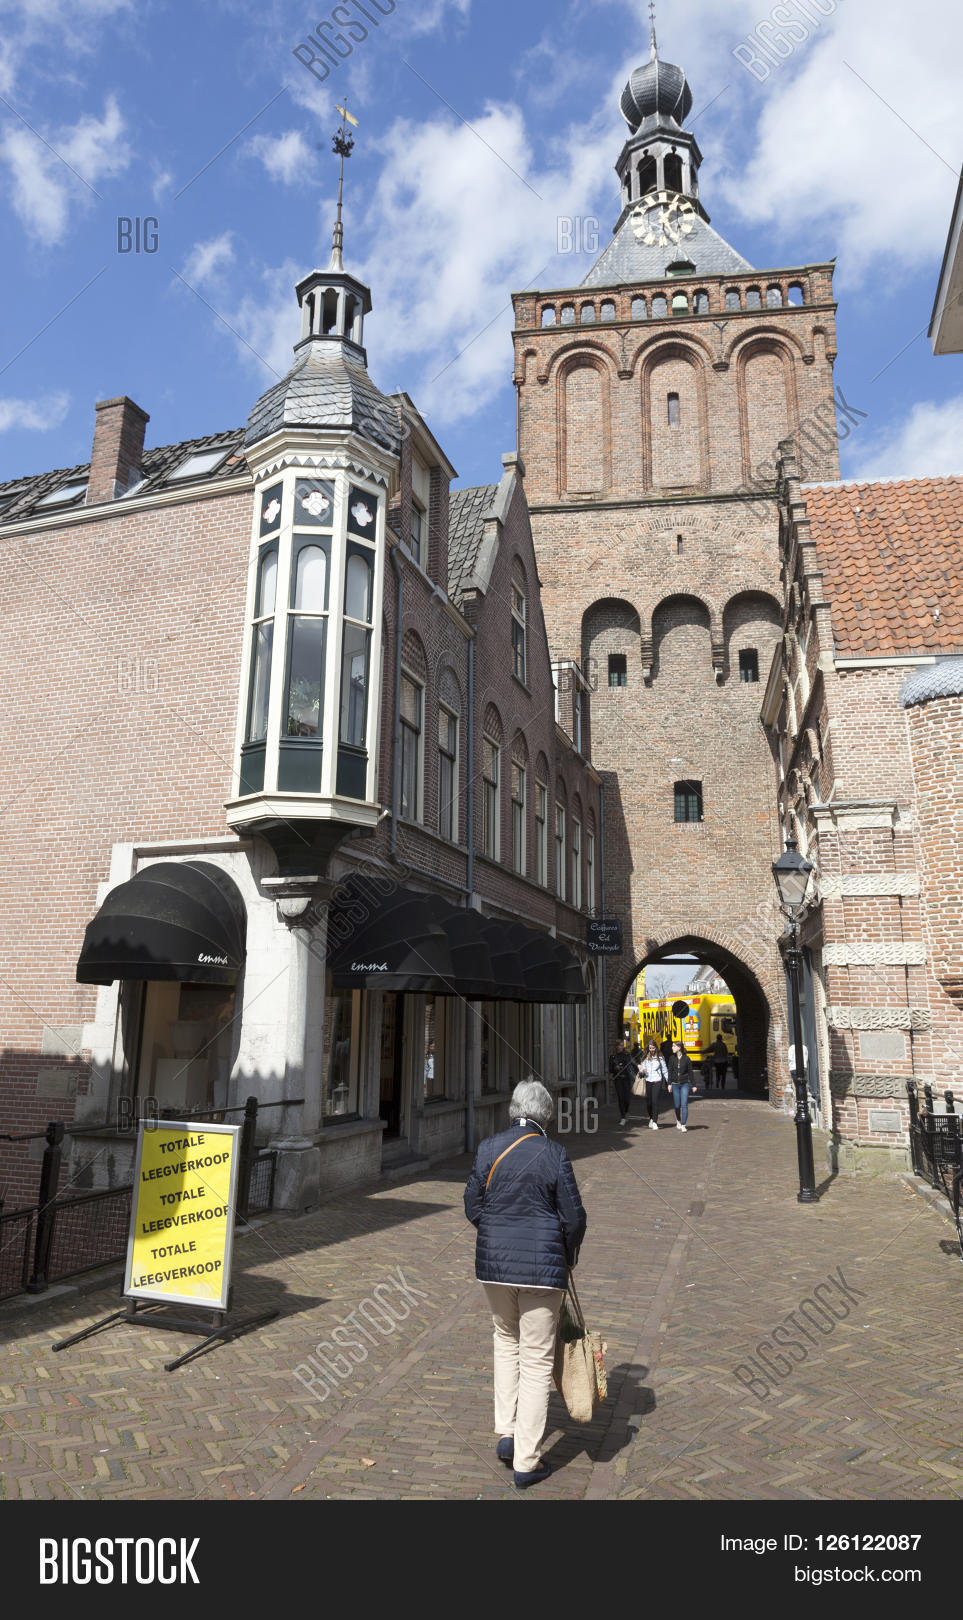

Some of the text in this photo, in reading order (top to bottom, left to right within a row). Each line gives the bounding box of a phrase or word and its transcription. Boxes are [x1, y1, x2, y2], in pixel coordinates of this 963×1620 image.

[198, 952, 228, 965] emma
[351, 962, 389, 972] emma
[643, 1010, 678, 1038] BROODBUS
[159, 1135, 205, 1154] TOTALE
[142, 1152, 230, 1182] LEEGVERKOOP
[159, 1187, 205, 1206] TOTALE
[150, 1241, 196, 1260] TOTALE
[133, 1260, 222, 1288] LEEGVERKOOP
